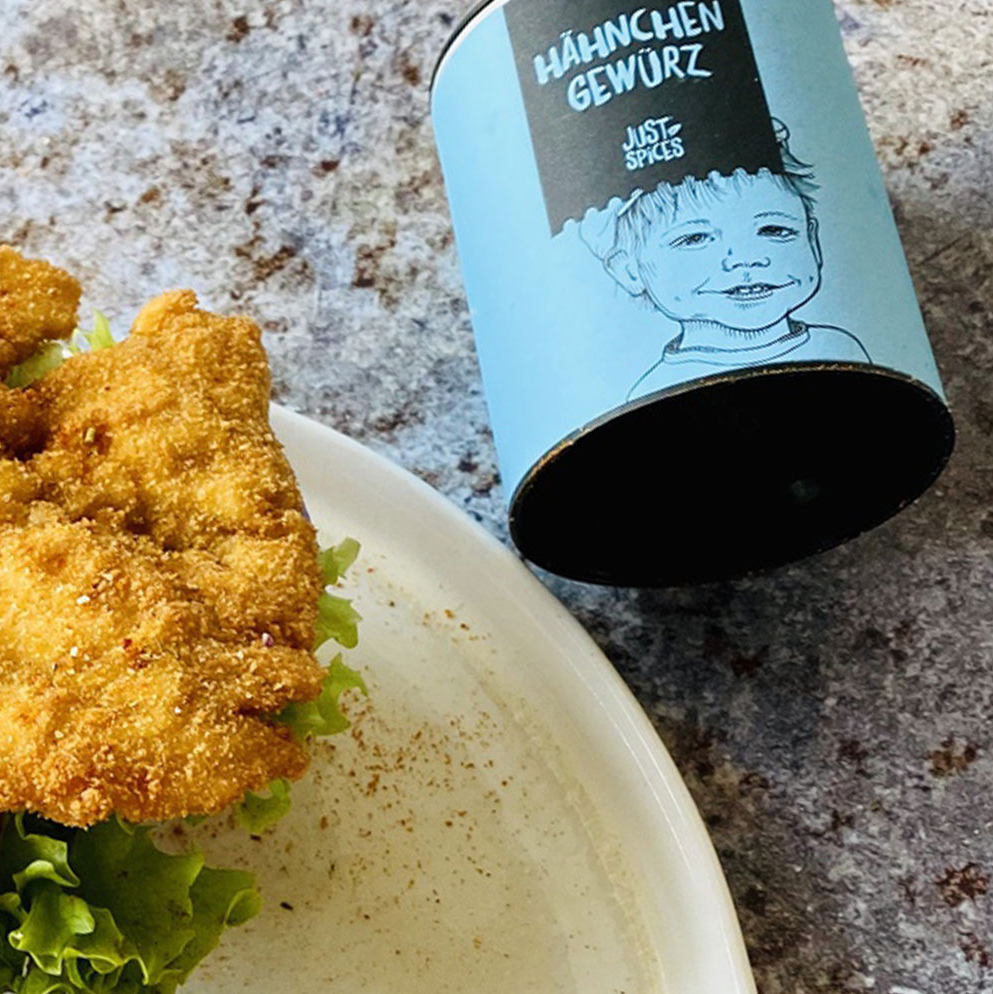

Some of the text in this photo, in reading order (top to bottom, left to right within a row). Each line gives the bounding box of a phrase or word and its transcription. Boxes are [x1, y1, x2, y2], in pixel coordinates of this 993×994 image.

[533, 0, 725, 85] HÄHNCHEN
[567, 43, 713, 112] GEWÜRZ
[622, 116, 674, 152] JUST
